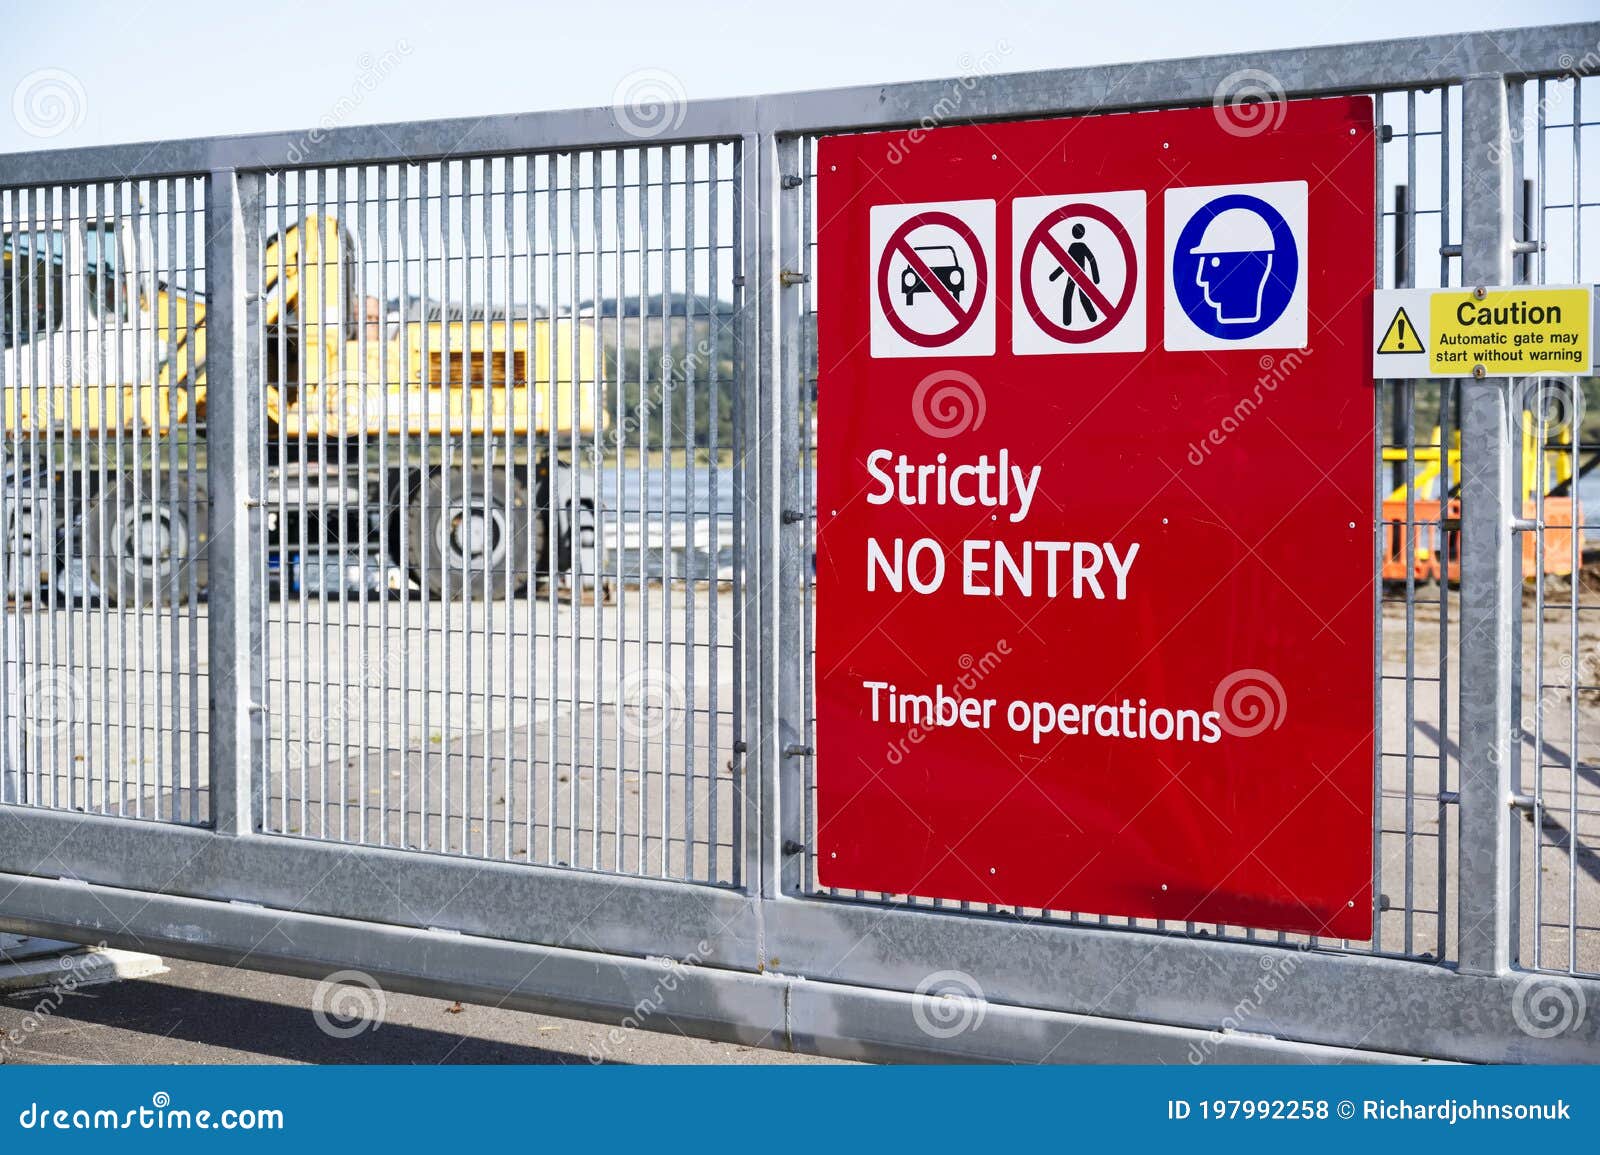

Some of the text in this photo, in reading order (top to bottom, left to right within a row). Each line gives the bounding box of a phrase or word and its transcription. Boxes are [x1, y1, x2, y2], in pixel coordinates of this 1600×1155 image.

[1457, 300, 1561, 326] Caution
[1436, 349, 1582, 362] start without warning
[1440, 333, 1579, 346] Automatic gate may
[867, 448, 1042, 523] Strictly
[867, 537, 1140, 600] NO ENTRY
[863, 681, 1222, 744] Timber operations
